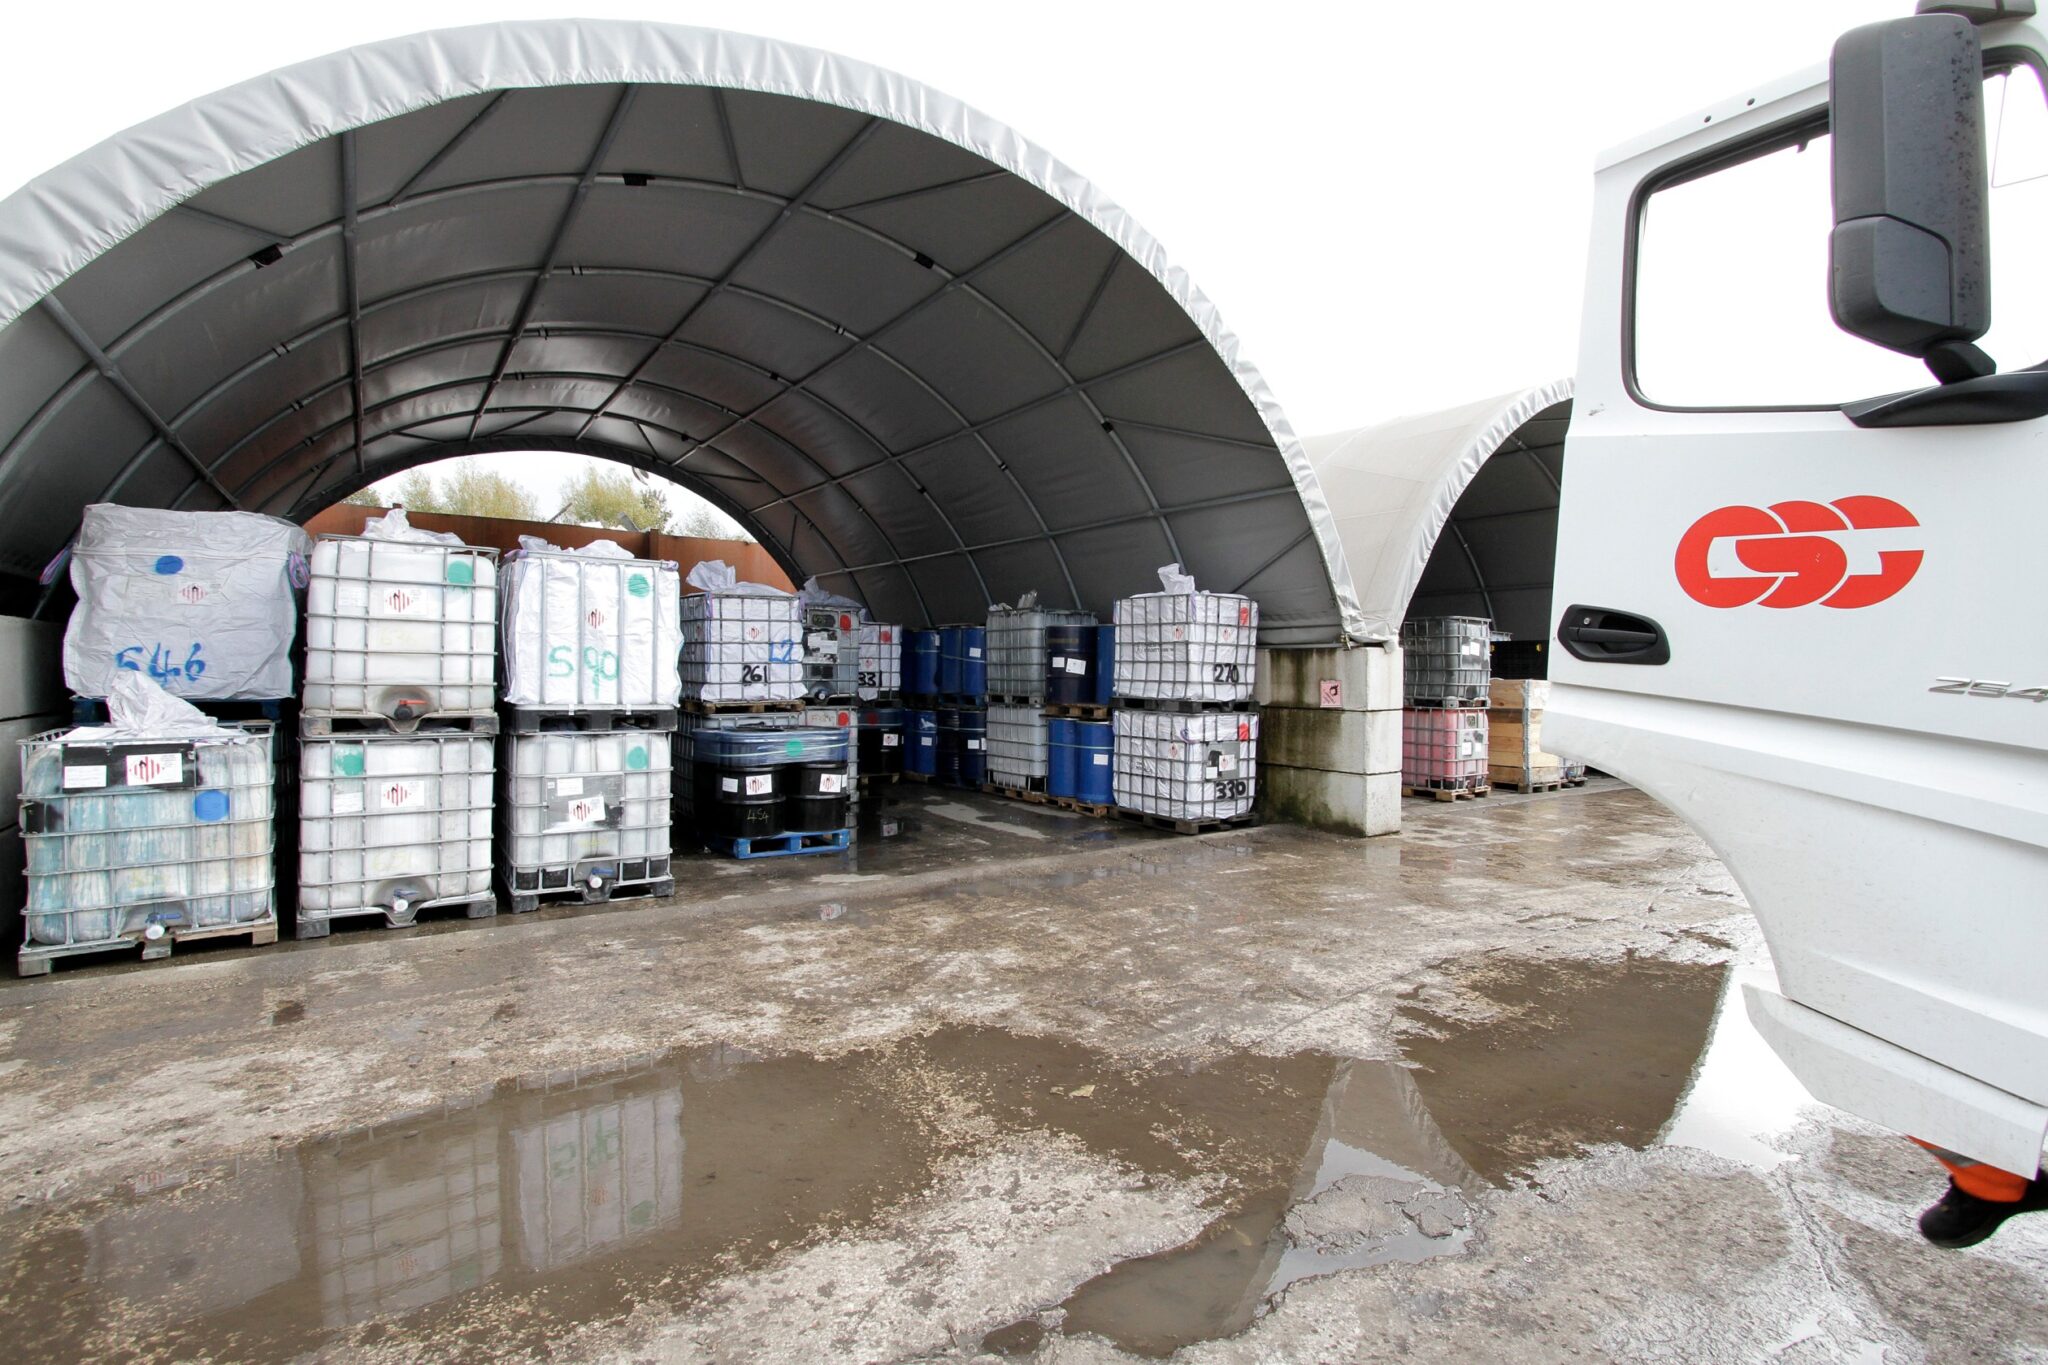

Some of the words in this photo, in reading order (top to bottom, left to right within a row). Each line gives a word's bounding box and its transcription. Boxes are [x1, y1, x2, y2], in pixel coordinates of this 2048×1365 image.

[115, 643, 206, 686] 546
[742, 664, 768, 686] 261
[1213, 663, 1240, 683] 270
[1216, 780, 1247, 800] 330
